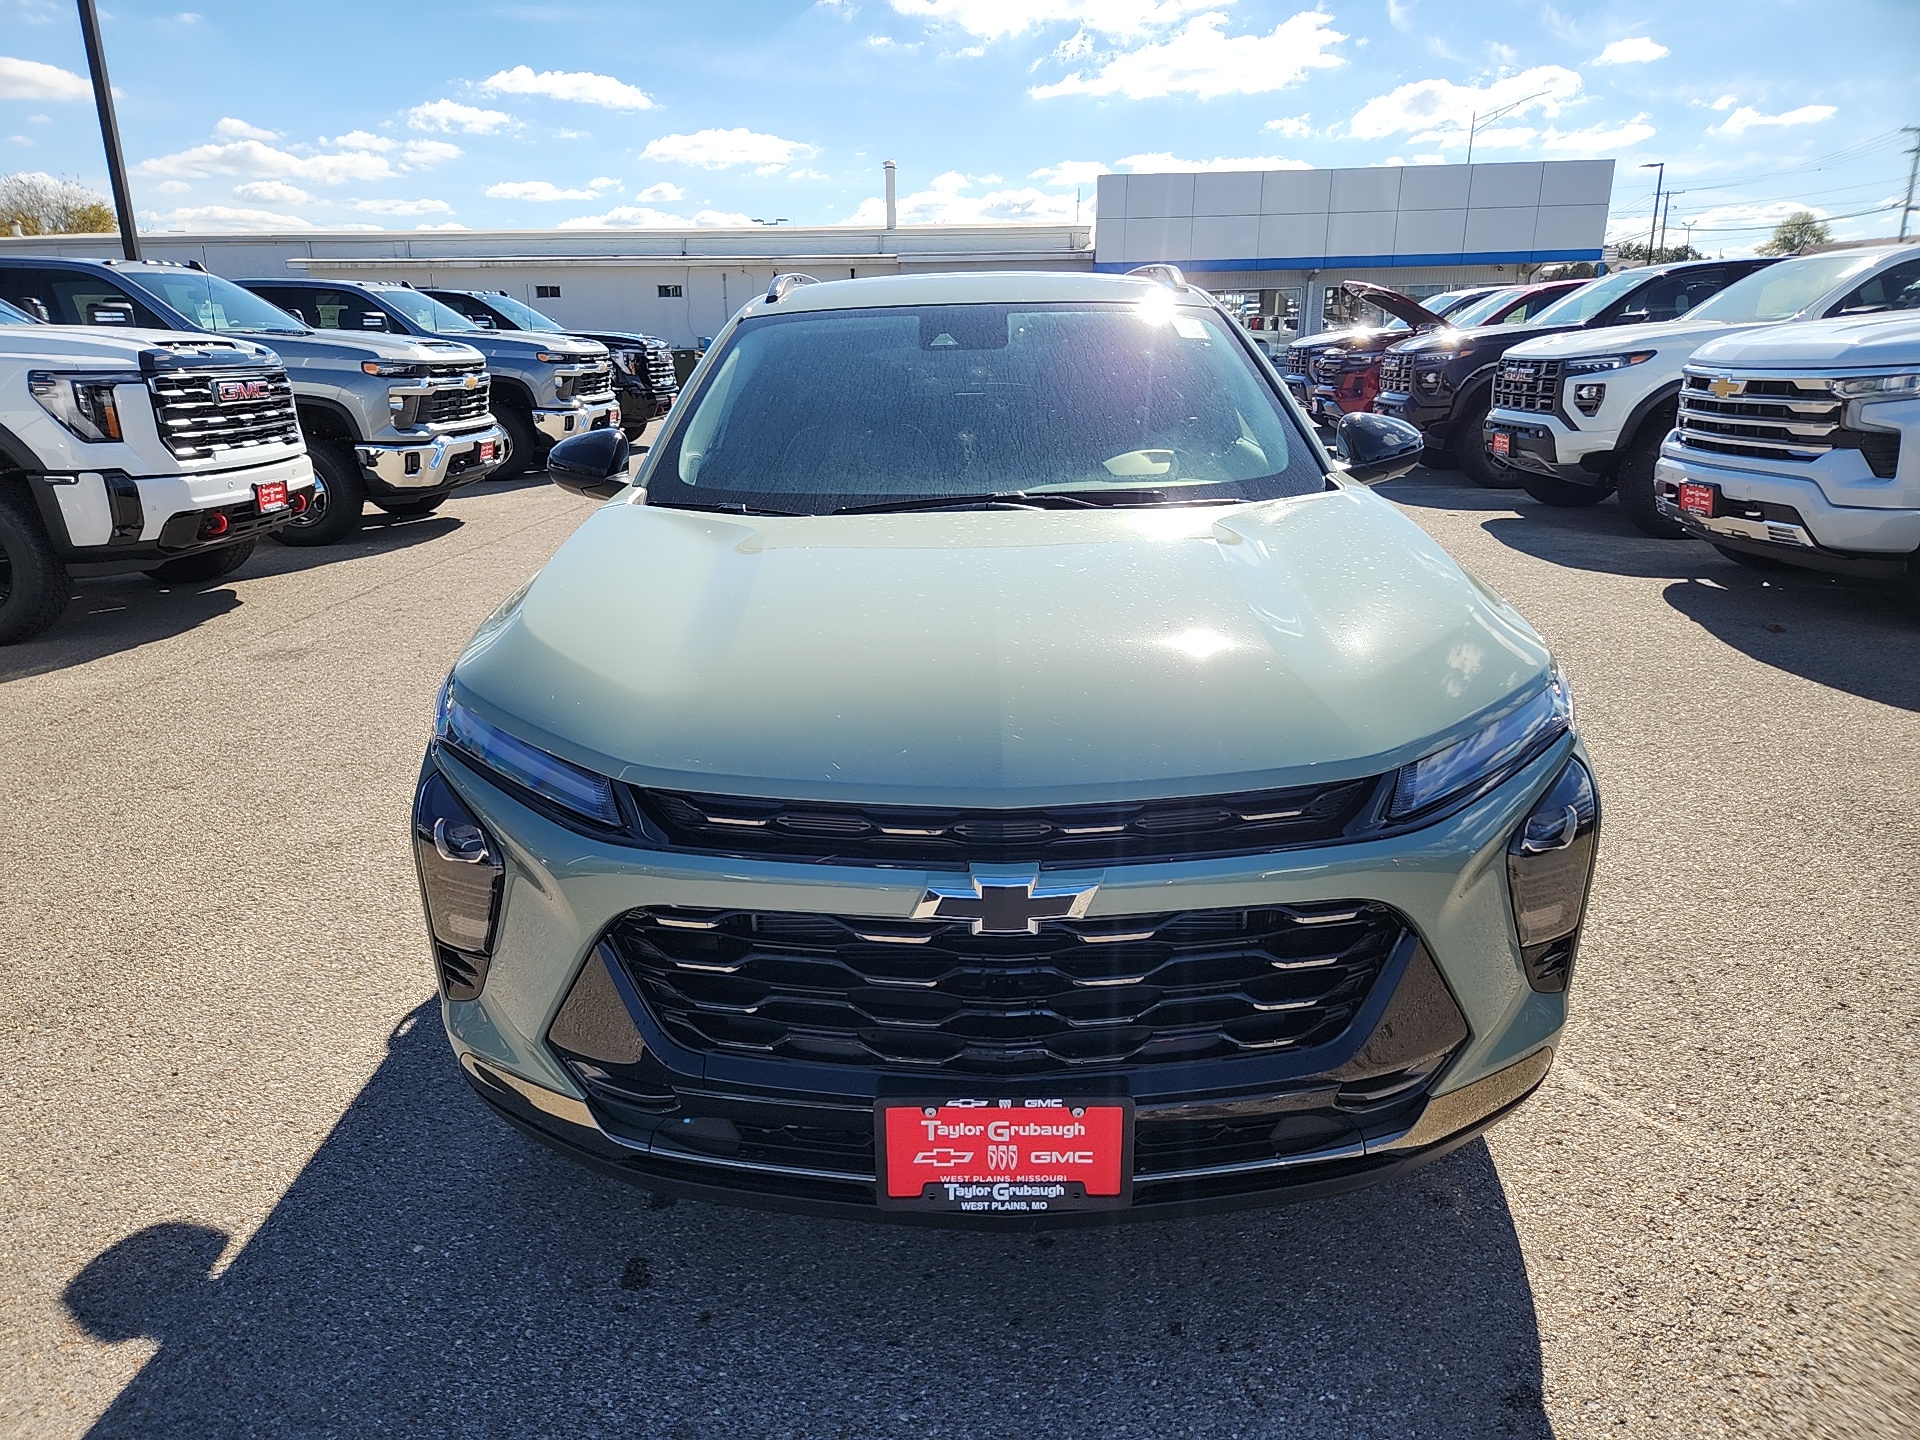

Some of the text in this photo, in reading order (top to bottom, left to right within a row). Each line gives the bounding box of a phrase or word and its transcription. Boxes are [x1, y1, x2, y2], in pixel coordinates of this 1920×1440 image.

[219, 381, 270, 401] GMC
[1024, 1099, 1063, 1108] GMC
[921, 1120, 1085, 1142] Taylor Grubaugh
[1030, 1151, 1094, 1164] GMC
[940, 1175, 970, 1183] WEST
[1016, 1174, 1067, 1183] MISSOURI
[943, 1183, 1065, 1201] Taylor Grubaugh
[960, 1201, 1048, 1211] WEST PLAINS, MO
